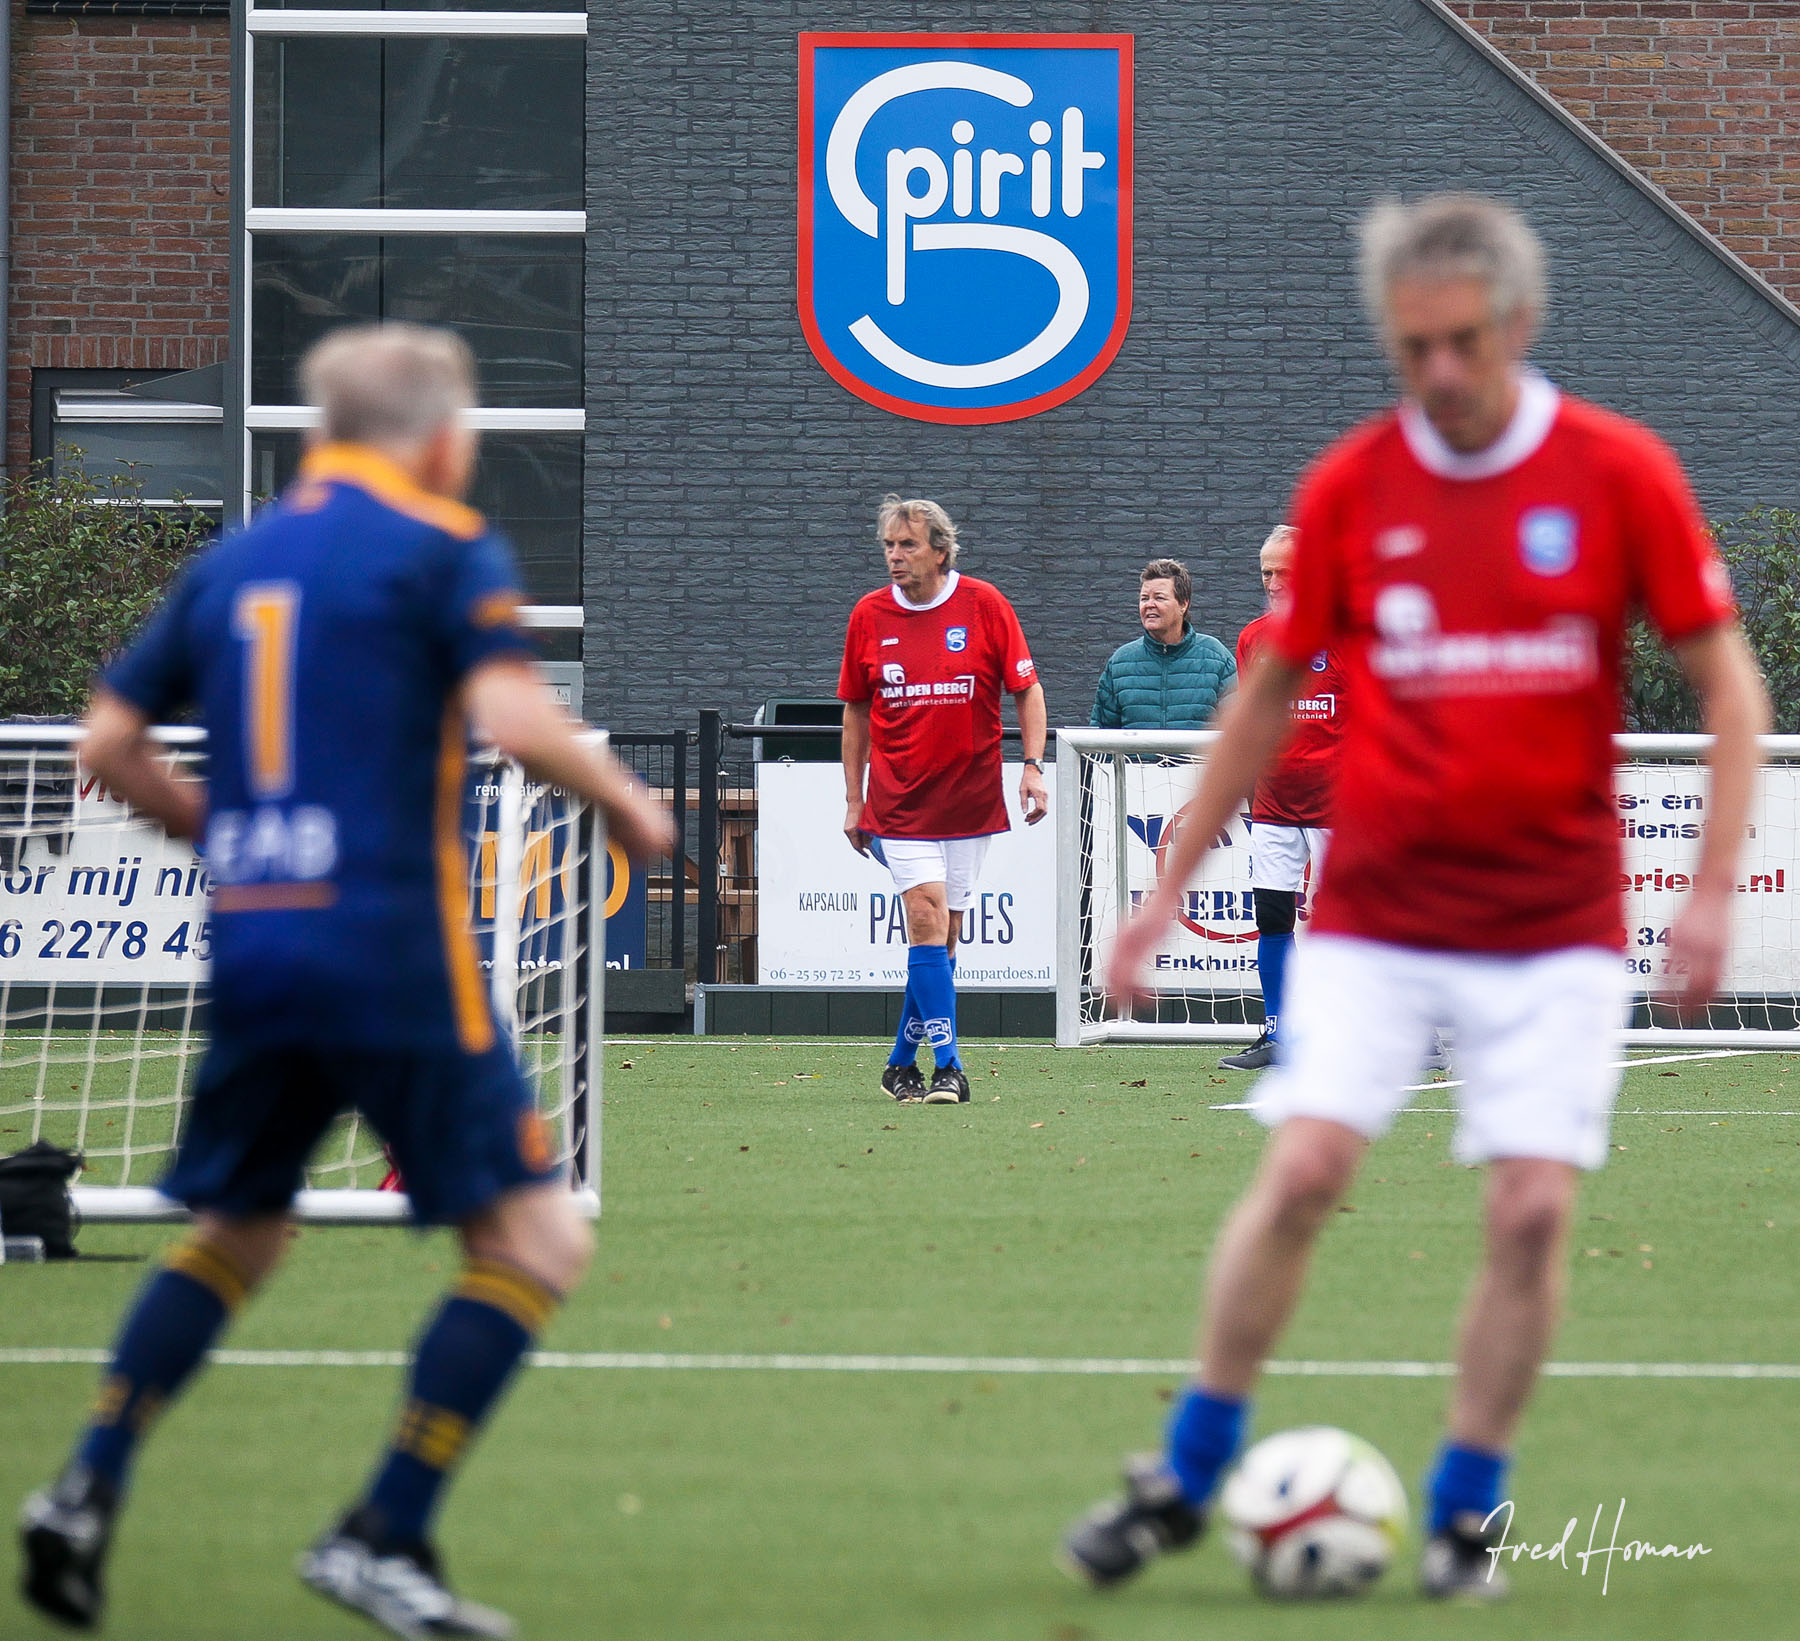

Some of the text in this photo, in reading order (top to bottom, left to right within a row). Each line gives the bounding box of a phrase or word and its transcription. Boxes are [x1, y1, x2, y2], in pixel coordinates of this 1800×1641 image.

[826, 61, 1106, 388] Spirit
[229, 580, 303, 800] 1
[880, 682, 968, 698] VAN DEN BERG
[1298, 700, 1329, 711] BERG
[1616, 794, 1703, 810] s- en
[0, 864, 56, 895] or
[67, 857, 142, 907] mij
[799, 892, 858, 911] KAPSALON
[869, 893, 1014, 944] PAOES
[38, 920, 149, 960] 2278
[813, 968, 827, 981] 59
[830, 970, 844, 981] 72
[848, 970, 861, 981] 25
